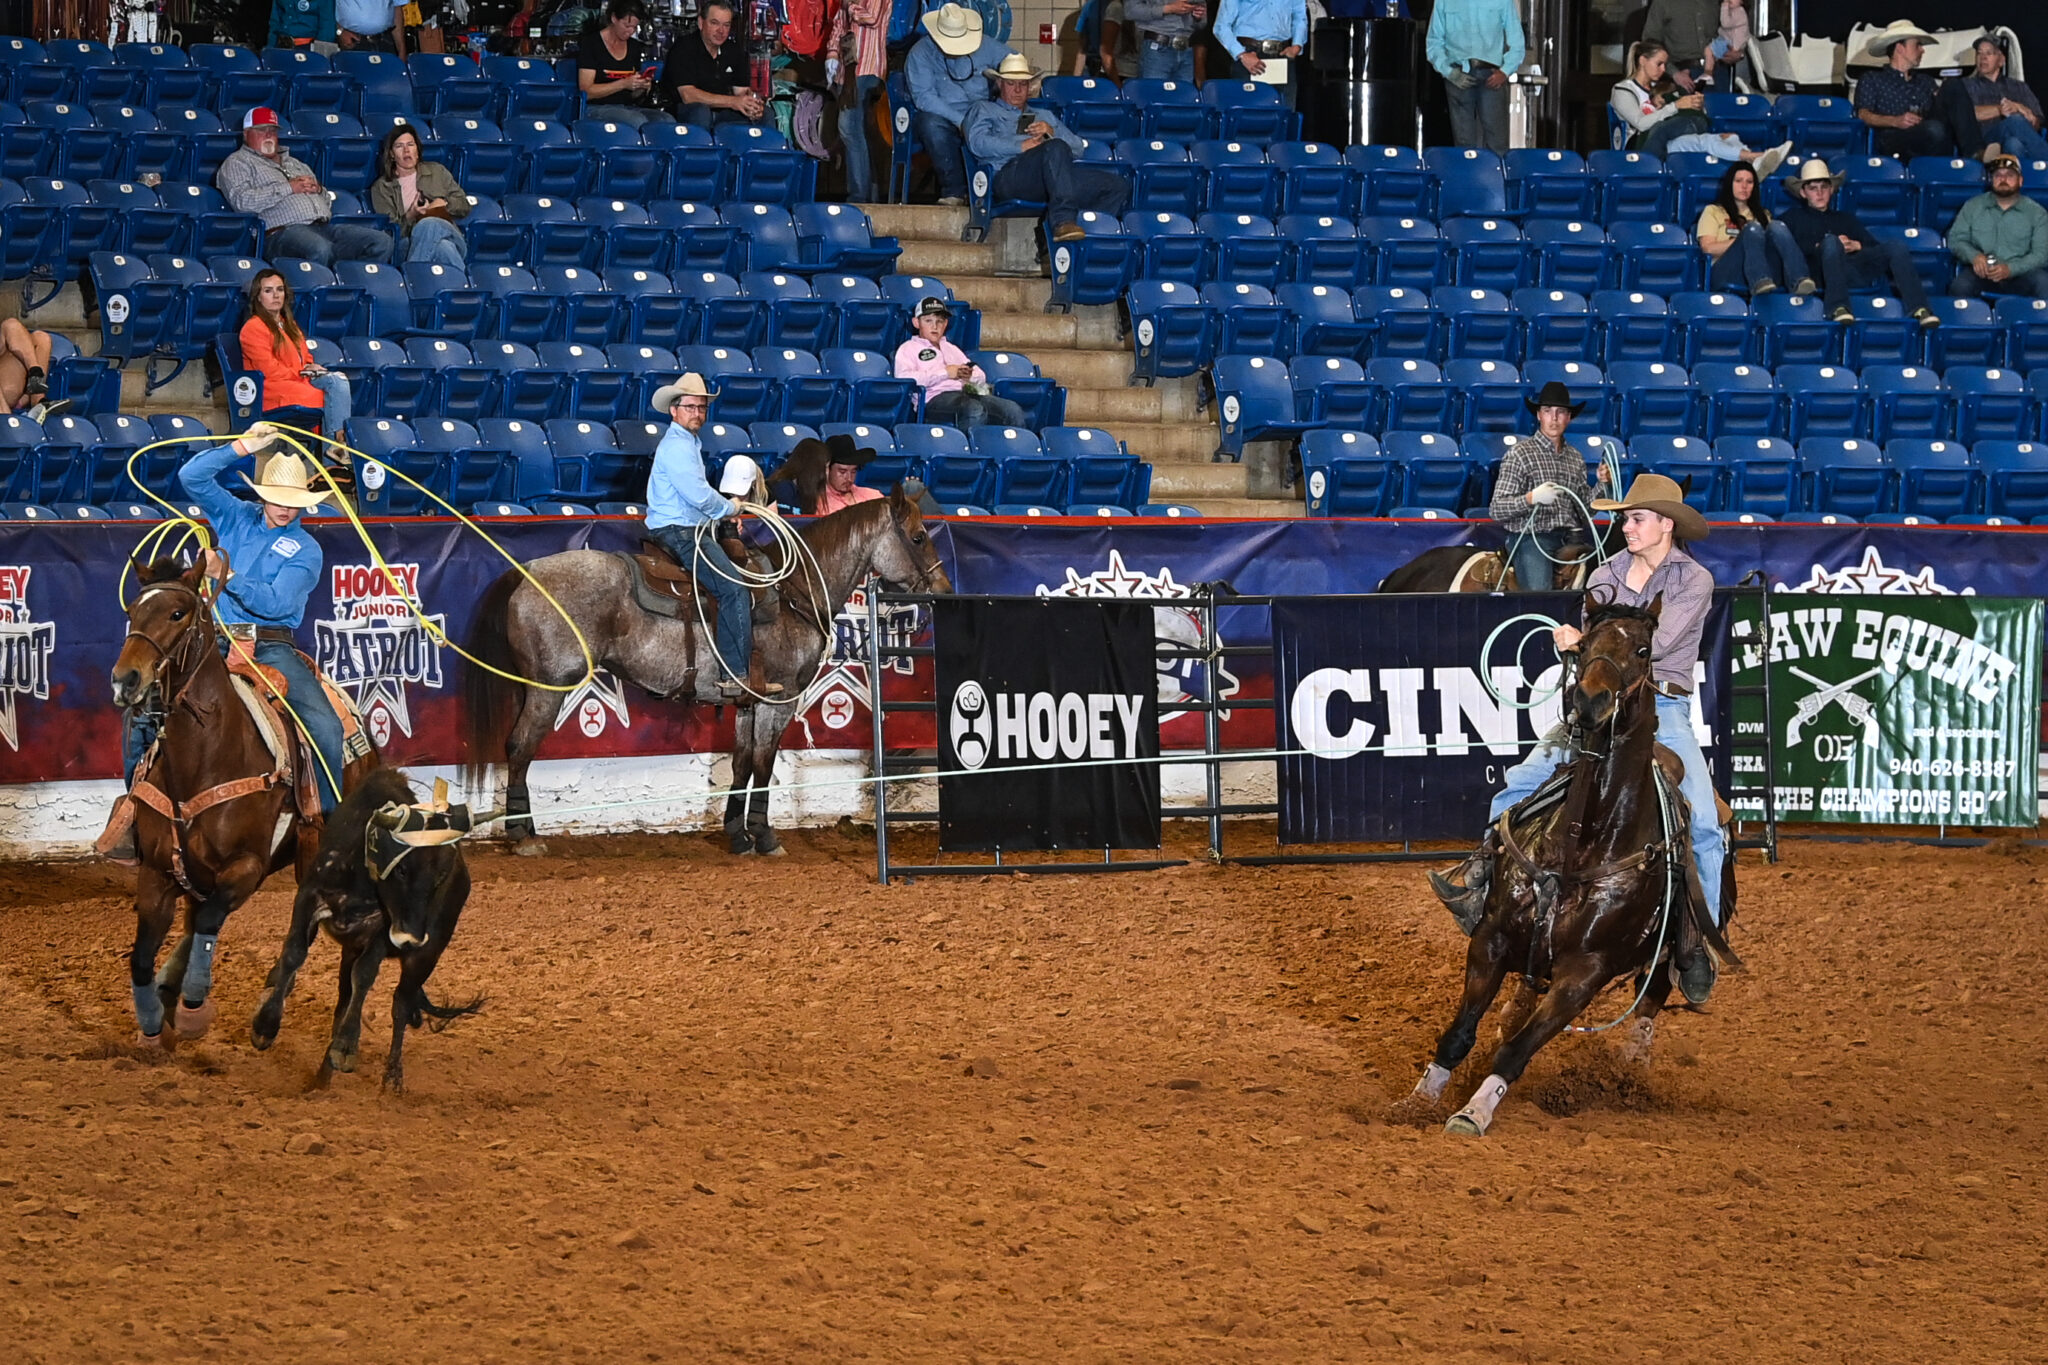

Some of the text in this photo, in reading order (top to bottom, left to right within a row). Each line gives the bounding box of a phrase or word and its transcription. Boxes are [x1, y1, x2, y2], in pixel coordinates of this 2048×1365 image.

[334, 566, 417, 598] HOOEY
[352, 603, 408, 620] JUNIOR
[316, 618, 441, 682] PATRIOT
[1732, 607, 2016, 706] LAW EQUINE
[996, 691, 1144, 760] HOOEY
[1737, 722, 1765, 734] DVM
[1912, 727, 2001, 739] and Associates
[1731, 755, 1766, 772] EXA
[1889, 758, 2017, 778] 940-626-8387
[1773, 786, 1814, 811] THE
[1820, 787, 1951, 814] CHAMPIONS
